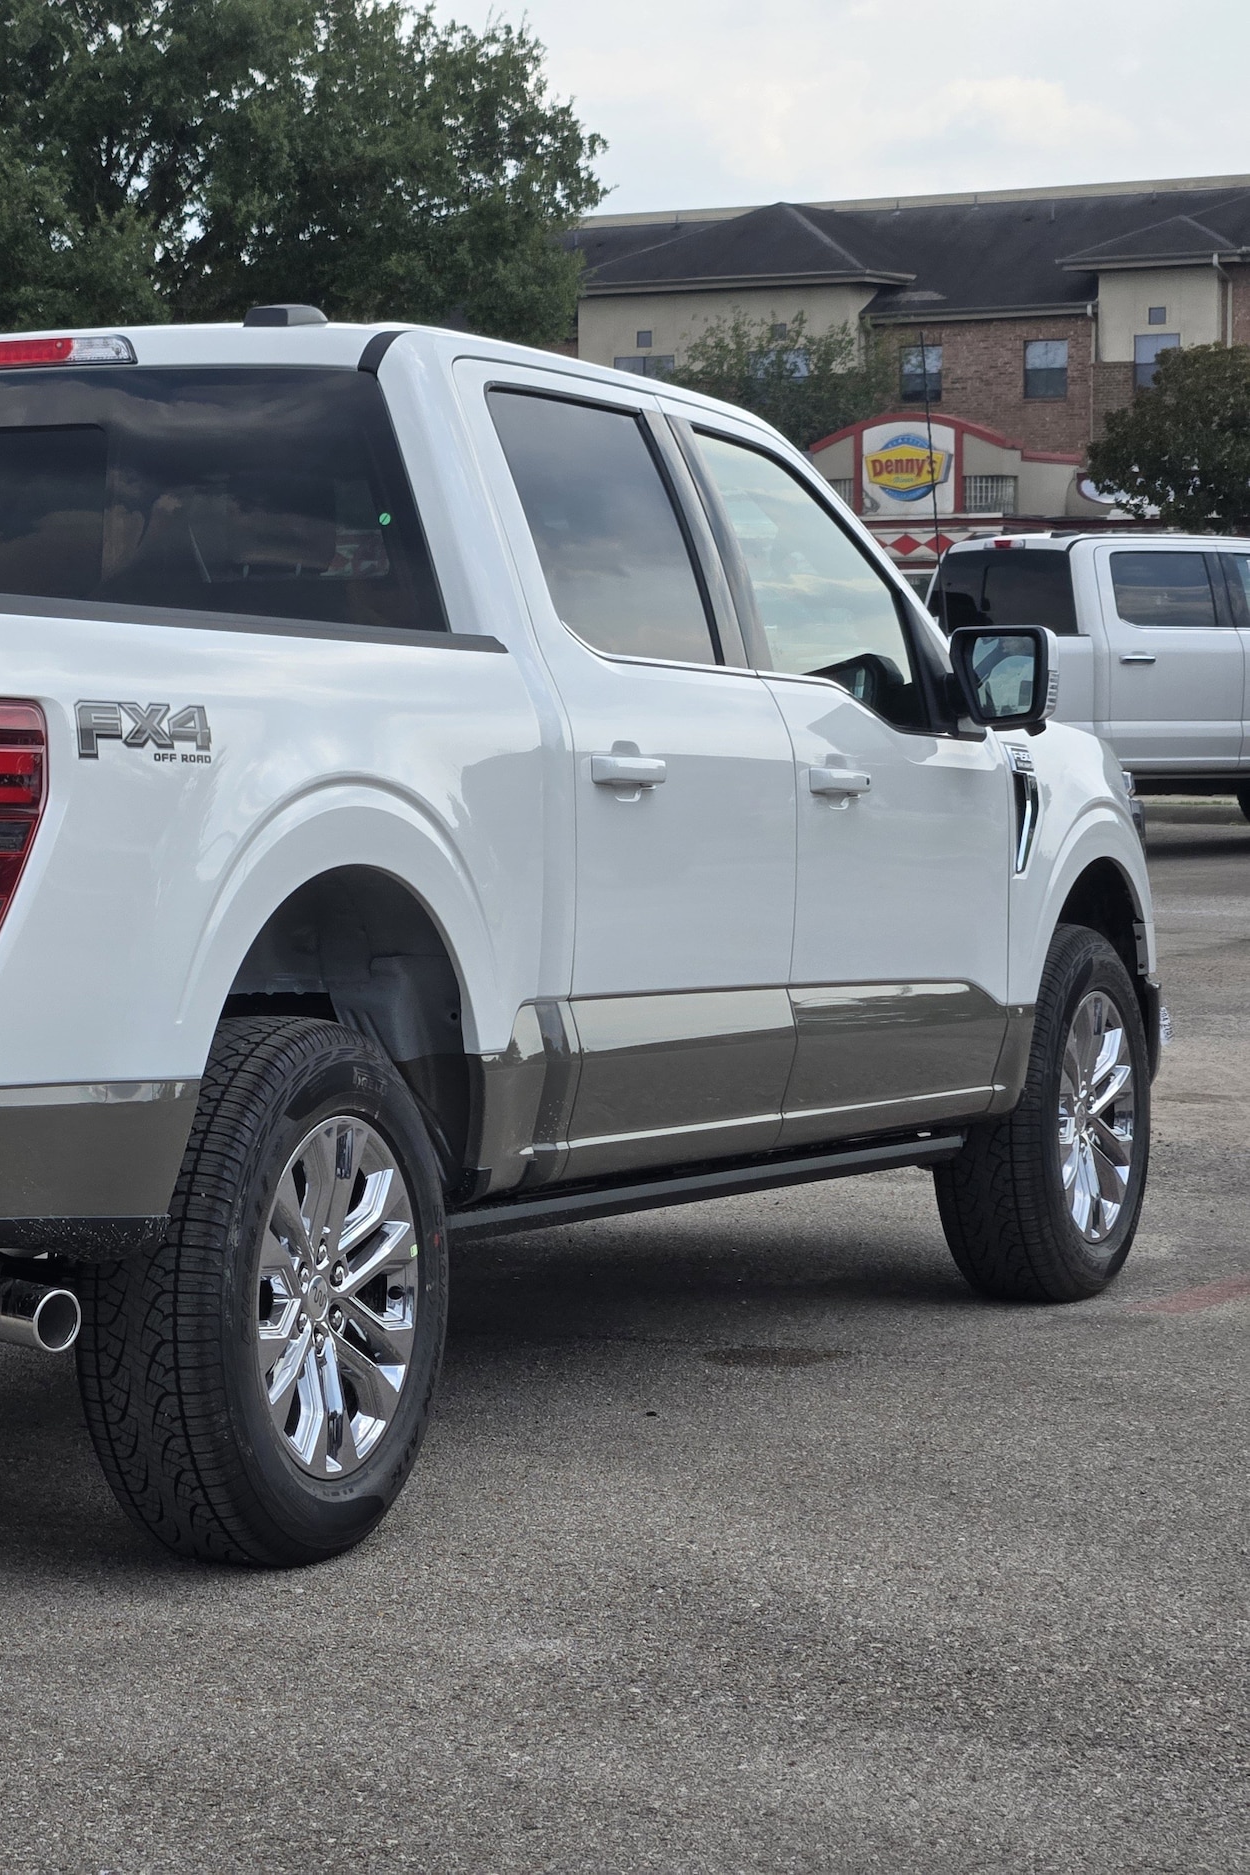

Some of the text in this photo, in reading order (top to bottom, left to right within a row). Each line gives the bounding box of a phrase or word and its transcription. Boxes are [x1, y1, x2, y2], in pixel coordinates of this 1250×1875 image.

[870, 455, 938, 478] Denny's
[74, 699, 212, 761] FX4
[153, 752, 212, 764] OFF ROAD
